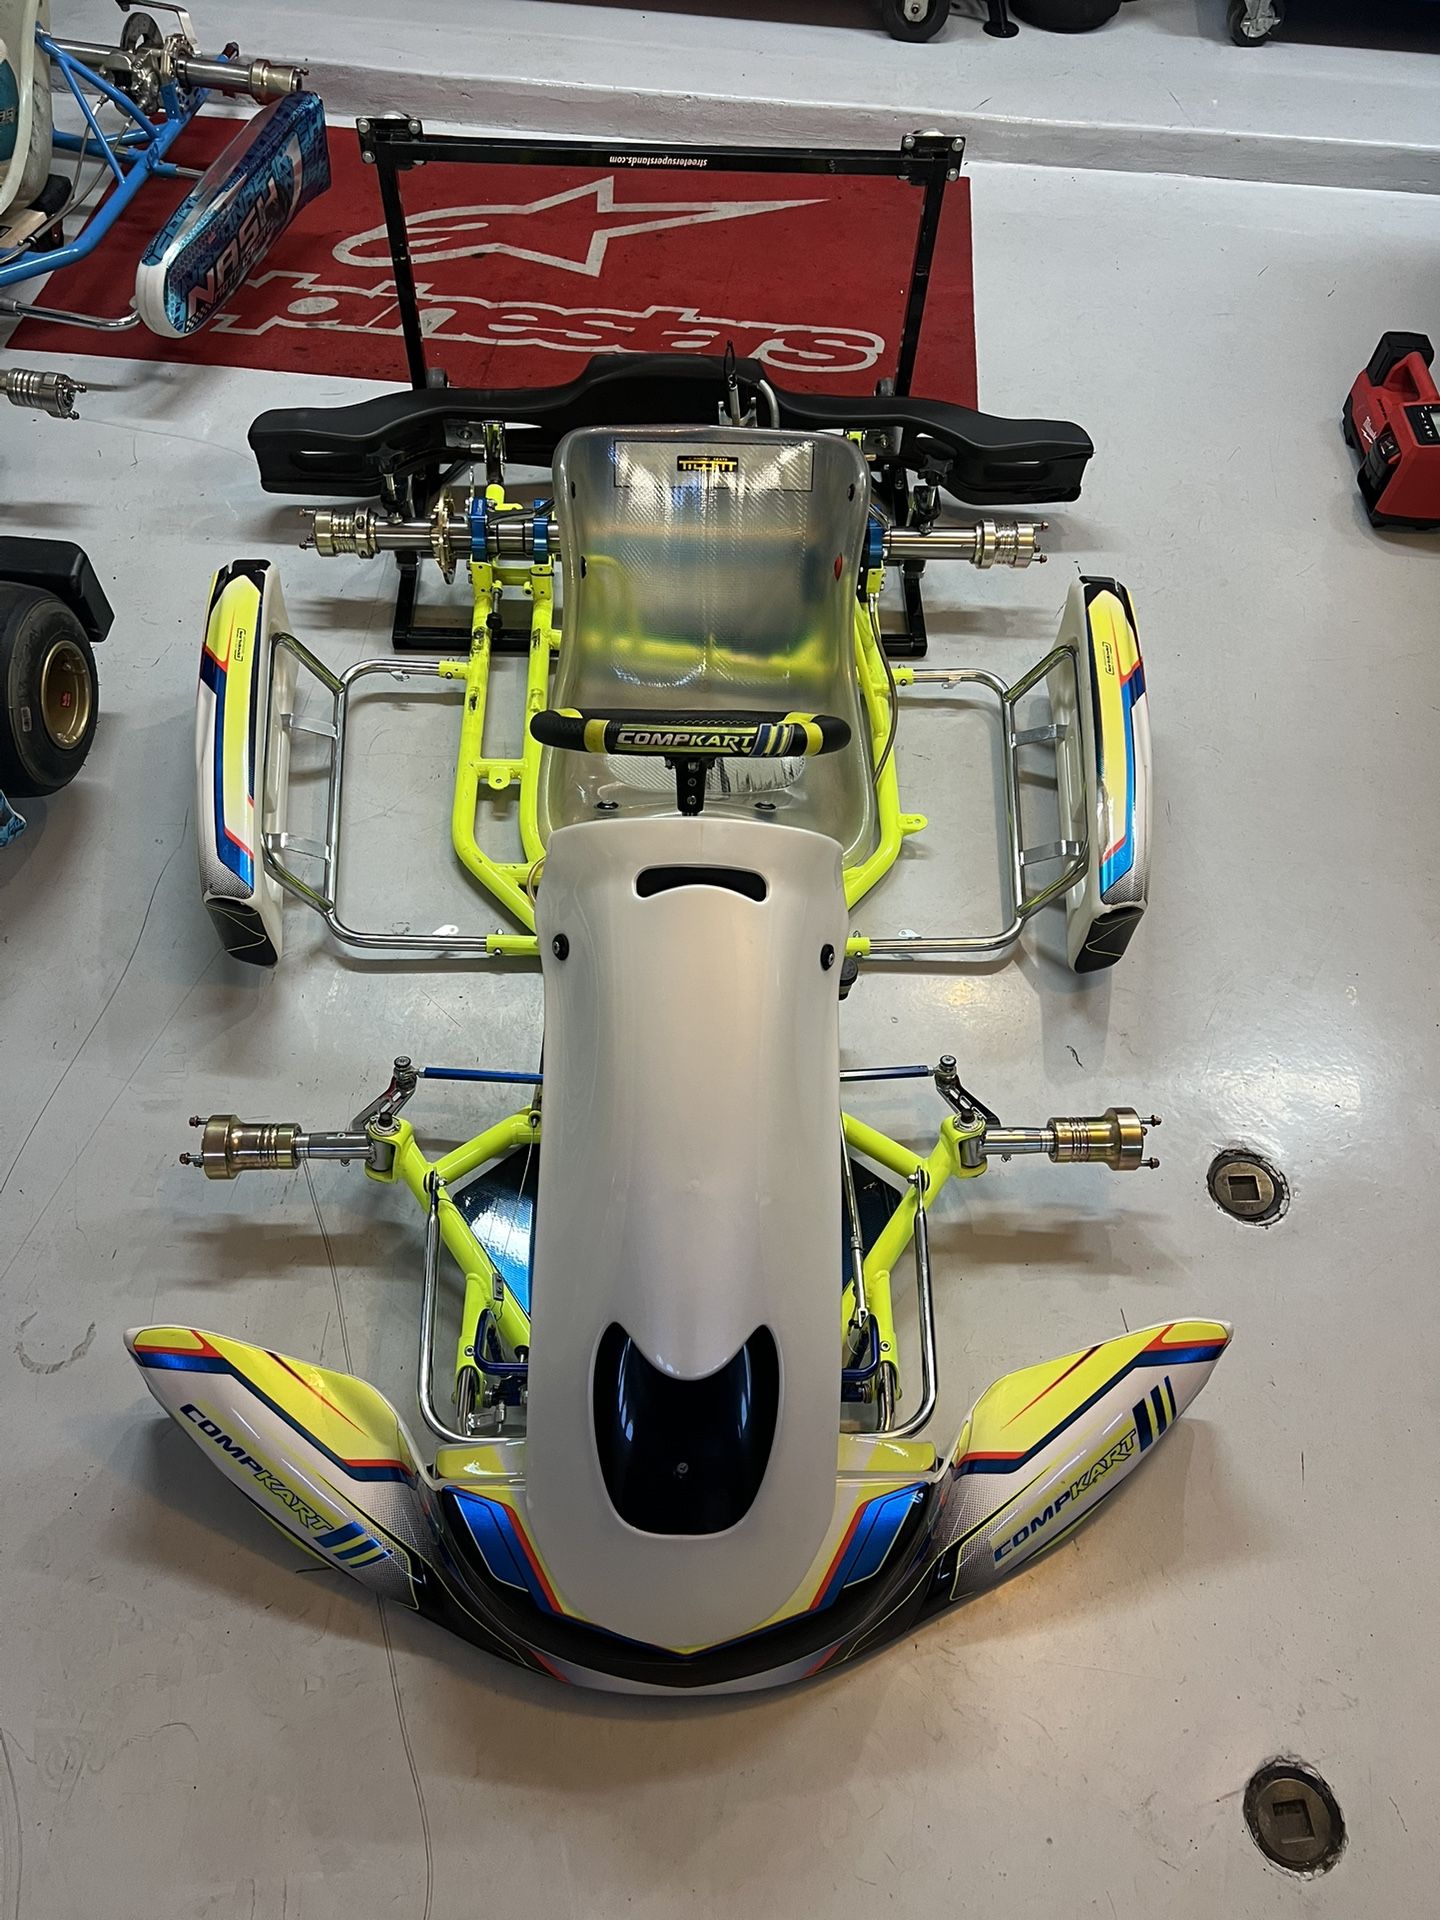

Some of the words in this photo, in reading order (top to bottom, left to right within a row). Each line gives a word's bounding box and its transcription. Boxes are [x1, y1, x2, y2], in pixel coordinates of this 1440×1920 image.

[609, 155, 708, 168] streetersuperstands.com
[188, 176, 278, 320] NASH
[616, 731, 754, 753] COMPKART
[179, 1403, 334, 1531] COMPKART
[993, 1428, 1137, 1563] COMPKART
